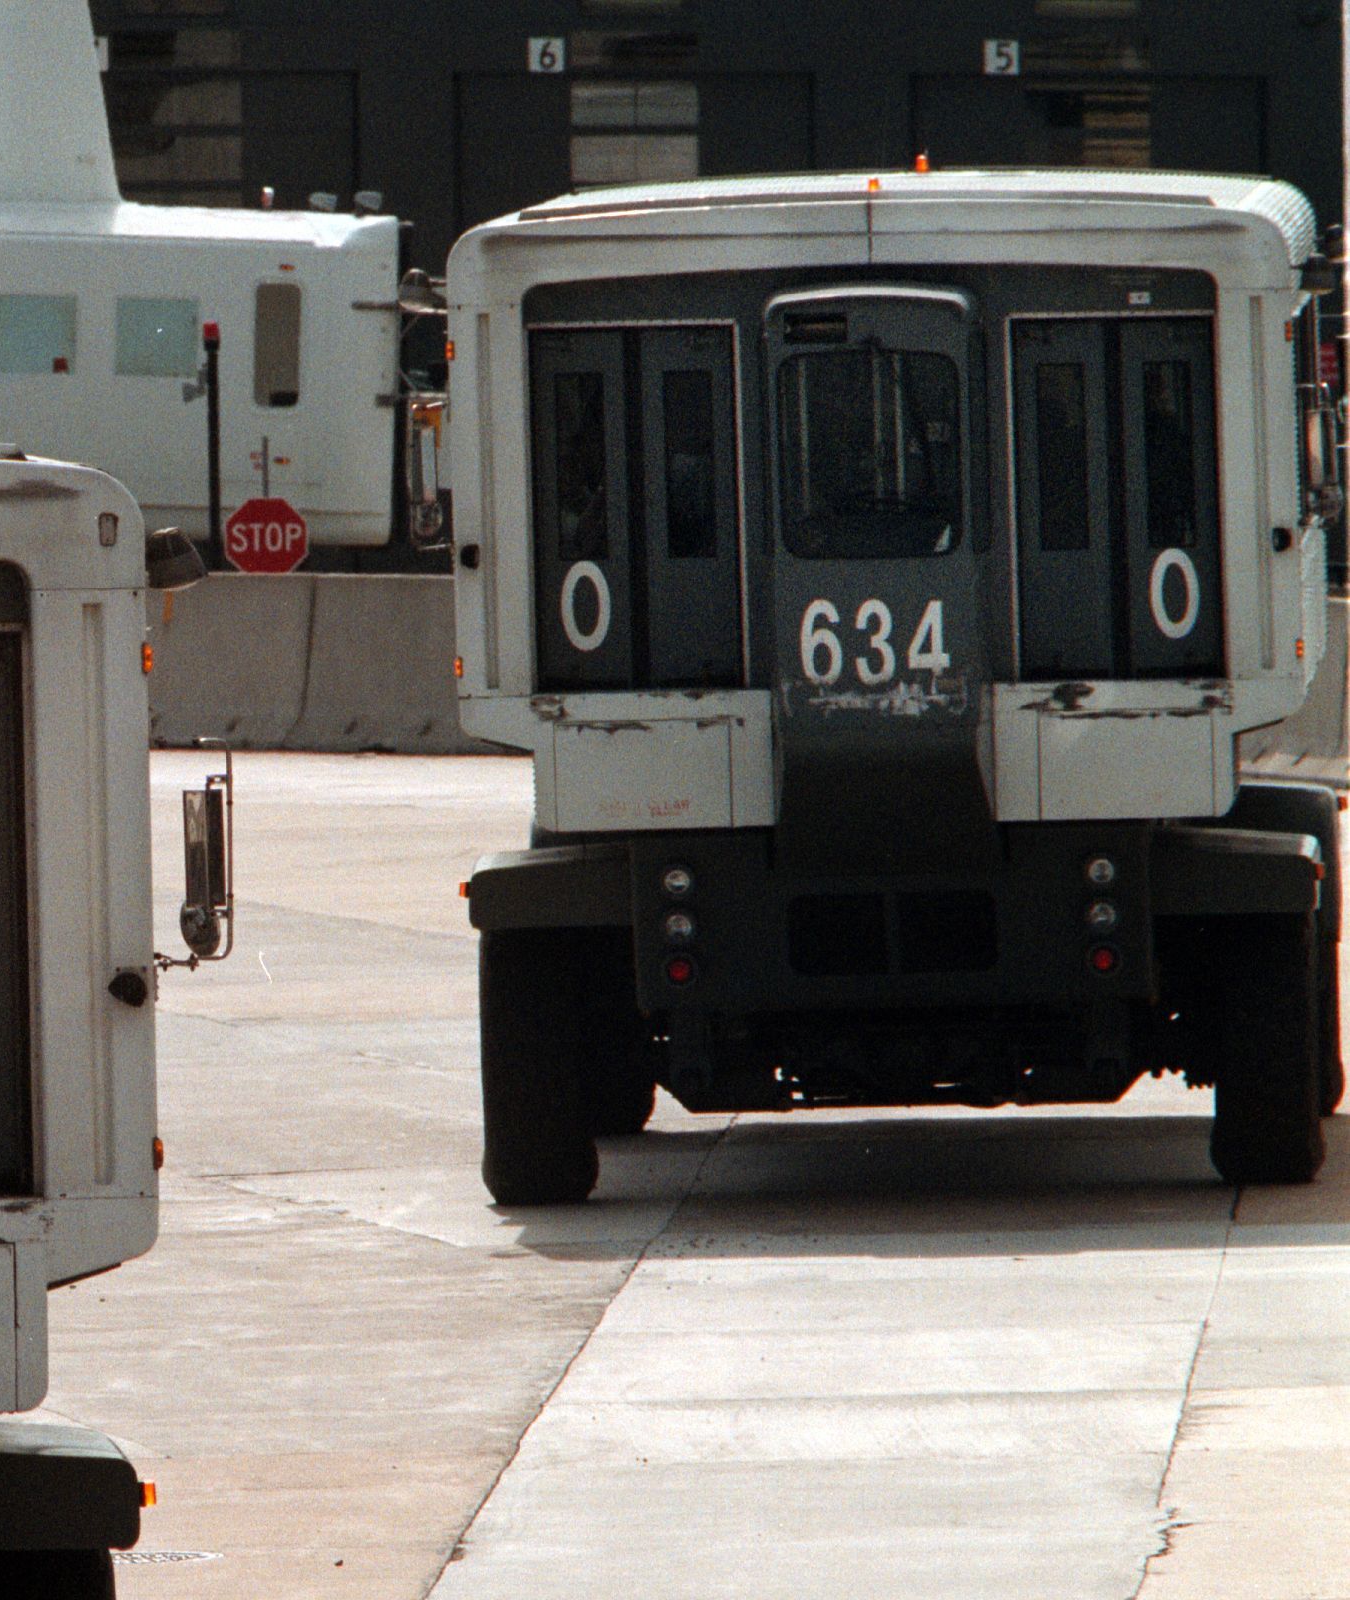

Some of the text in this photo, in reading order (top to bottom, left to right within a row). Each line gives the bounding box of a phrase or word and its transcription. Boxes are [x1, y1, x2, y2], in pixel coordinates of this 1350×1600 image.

[539, 41, 557, 69] 6
[995, 43, 1013, 71] 5
[231, 523, 303, 551] STOP
[800, 598, 951, 685] 634
